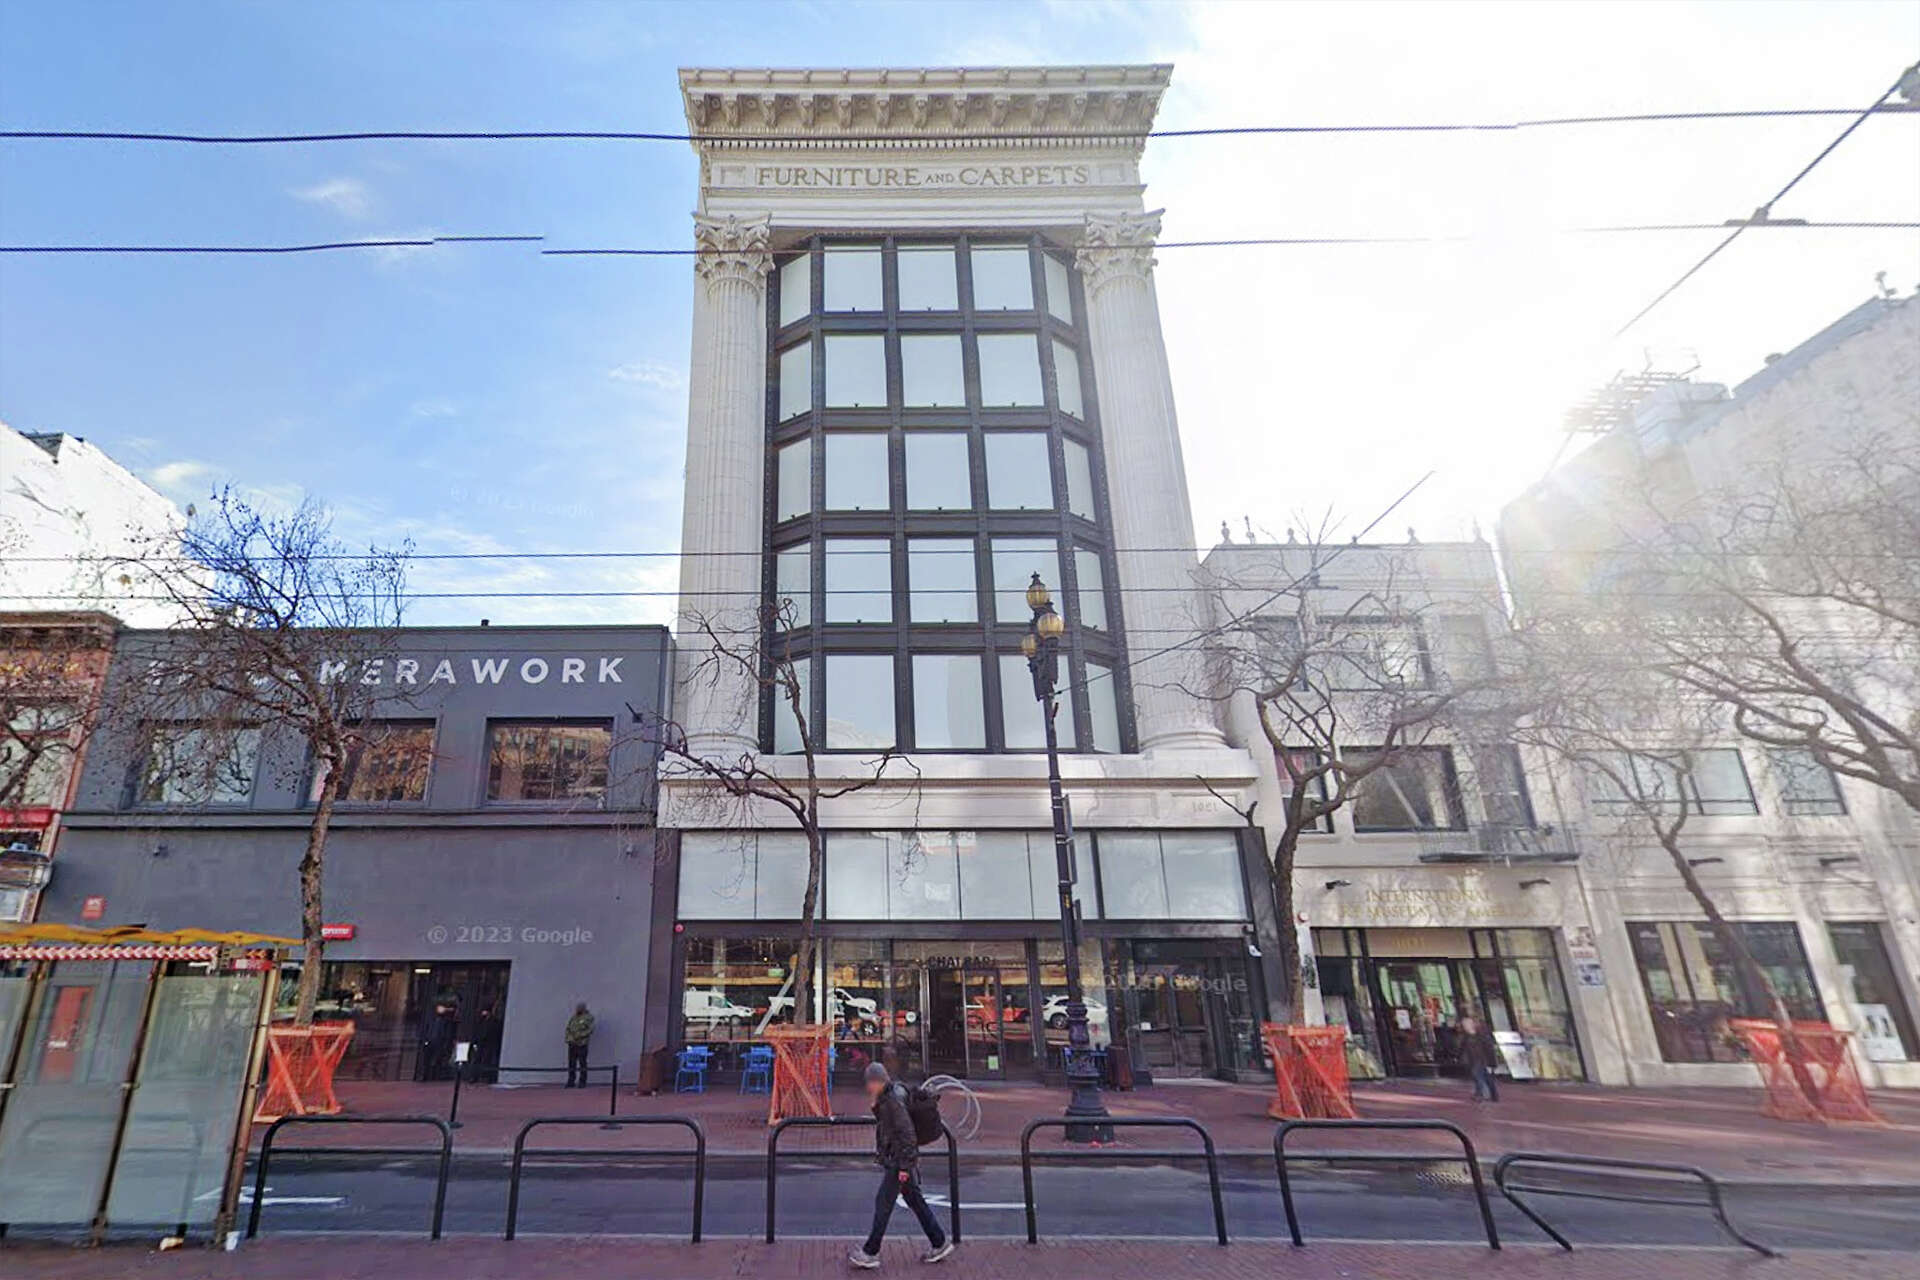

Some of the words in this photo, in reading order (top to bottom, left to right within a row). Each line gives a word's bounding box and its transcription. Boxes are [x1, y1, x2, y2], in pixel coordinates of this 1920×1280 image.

[757, 167, 922, 187] FURNITURE
[925, 173, 956, 185] AND
[958, 165, 1088, 186] CARPETS
[248, 656, 624, 686] MERAWORK
